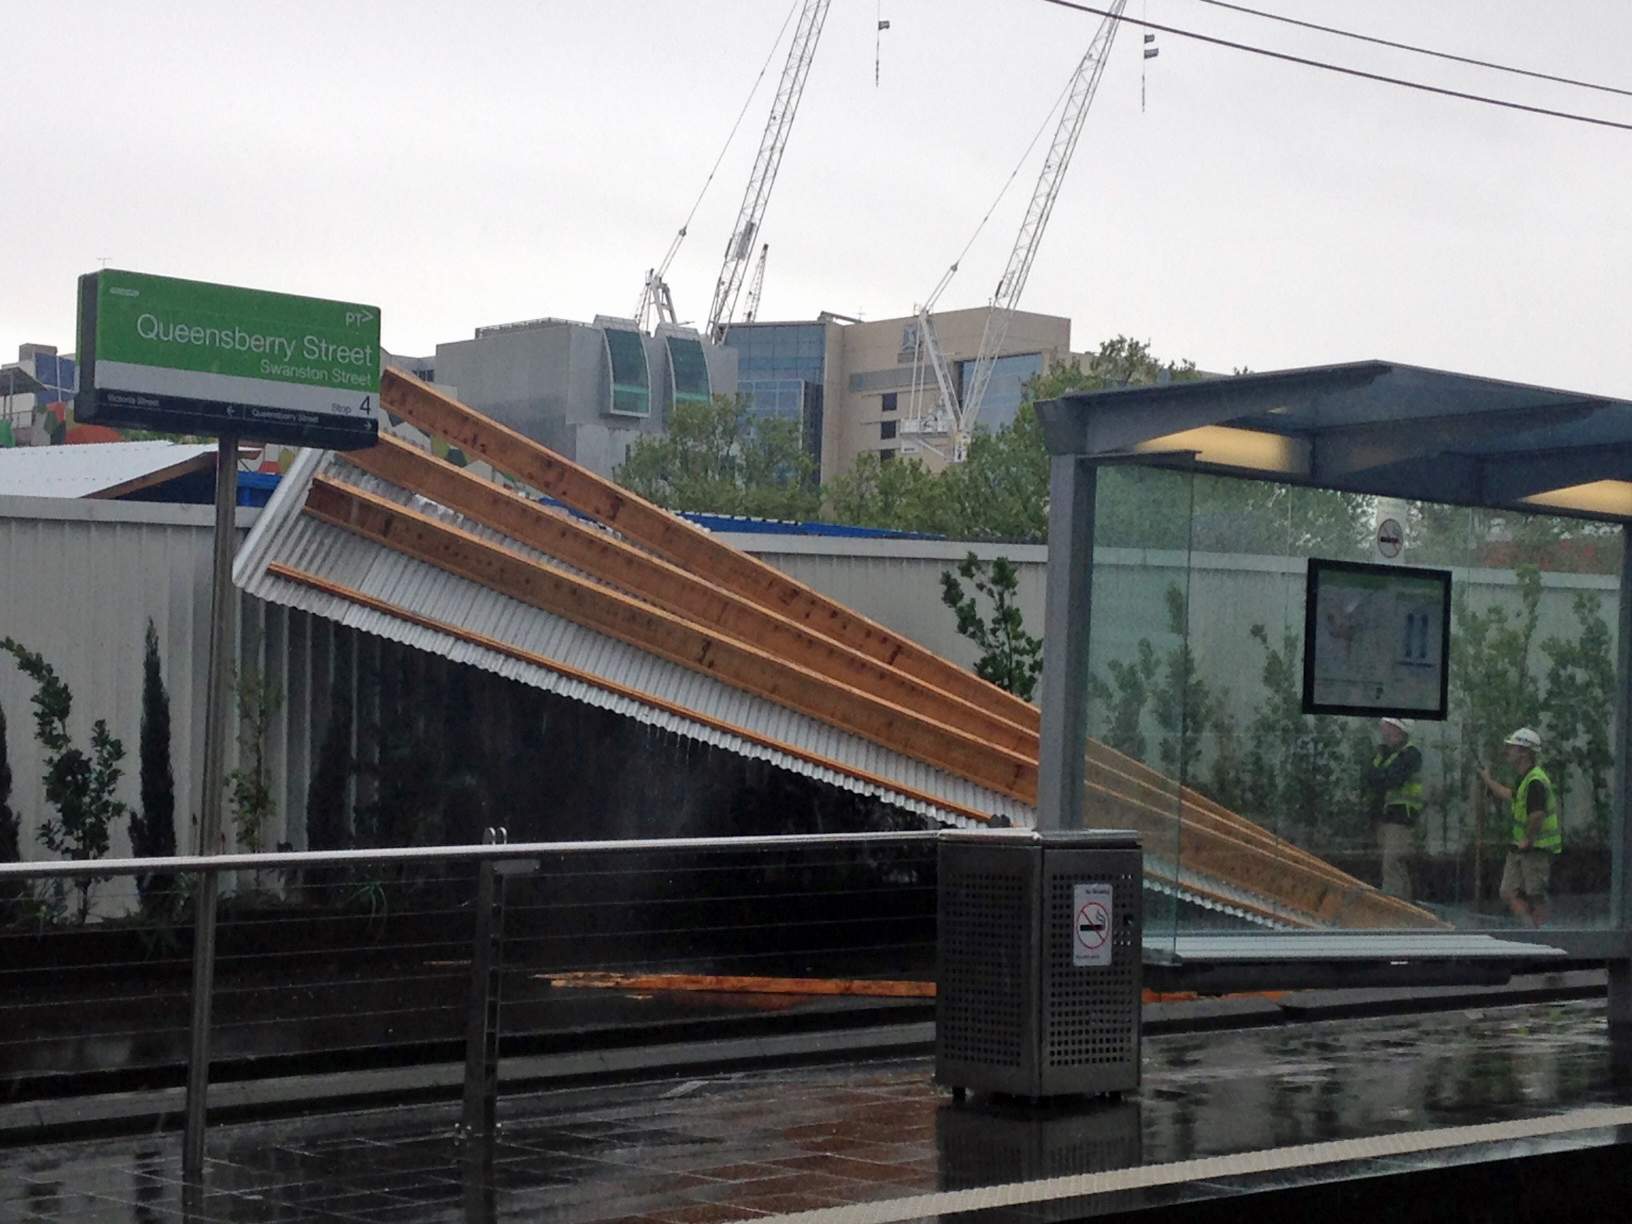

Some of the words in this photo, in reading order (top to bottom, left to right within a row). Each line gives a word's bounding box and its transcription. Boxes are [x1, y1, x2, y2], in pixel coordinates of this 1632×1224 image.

[136, 313, 297, 358] Queensberry
[303, 335, 372, 366] Street
[260, 358, 329, 381] Swanston
[332, 369, 372, 387] Street
[359, 395, 371, 416] 4
